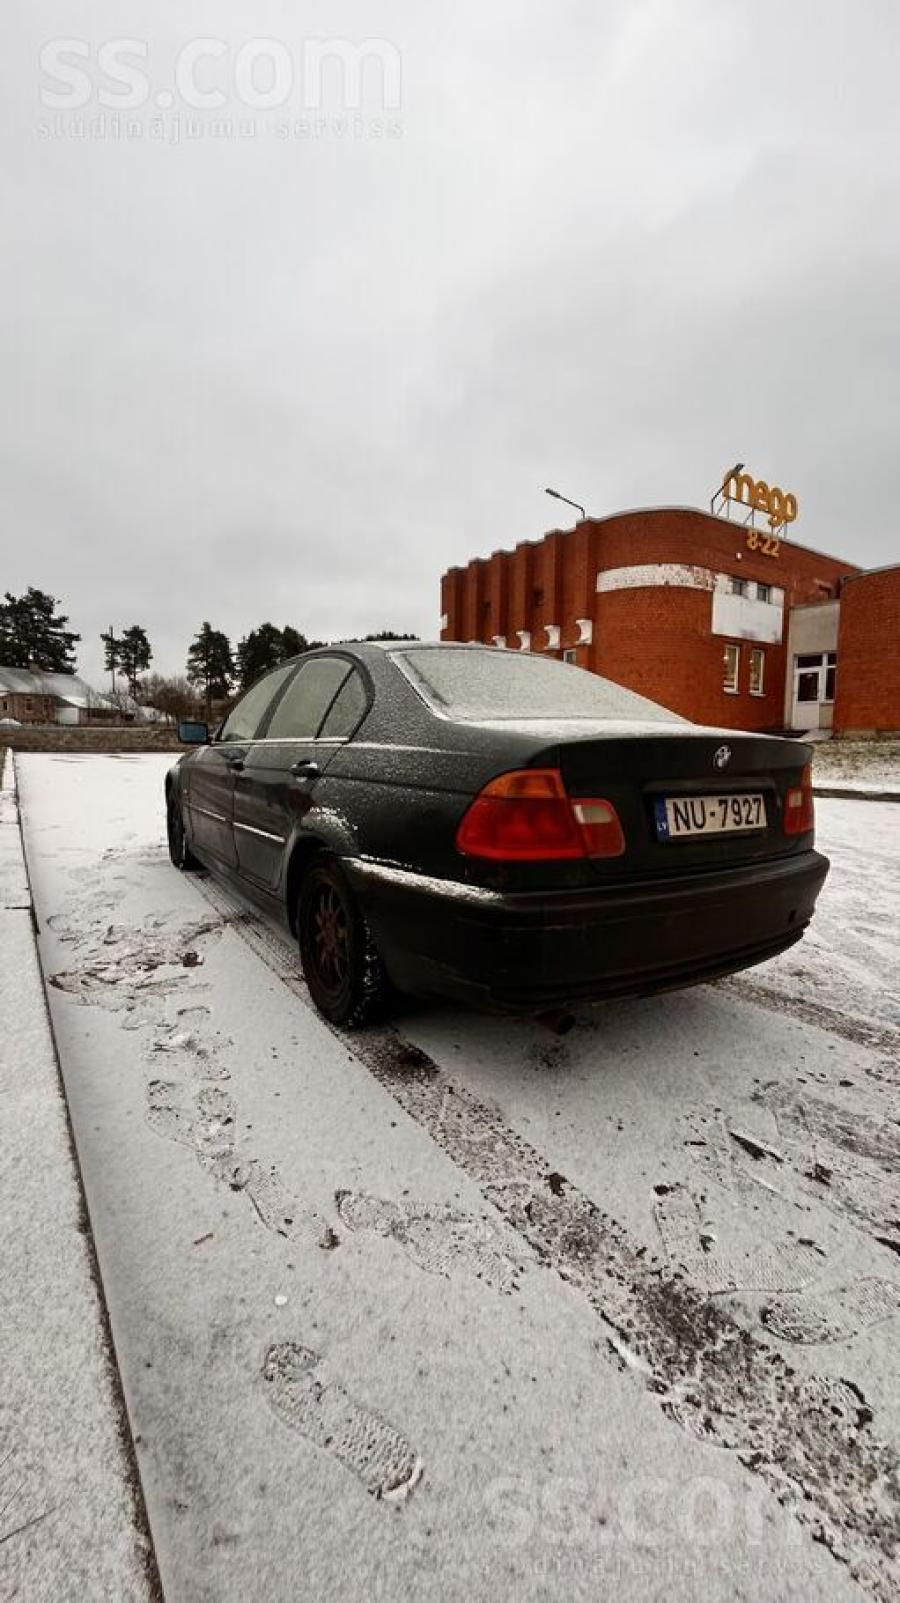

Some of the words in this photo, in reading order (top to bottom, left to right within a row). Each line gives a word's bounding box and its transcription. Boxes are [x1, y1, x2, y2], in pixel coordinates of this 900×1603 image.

[722, 470, 797, 526] mego
[747, 530, 780, 557] 8-22
[672, 797, 762, 832] NU-7927
